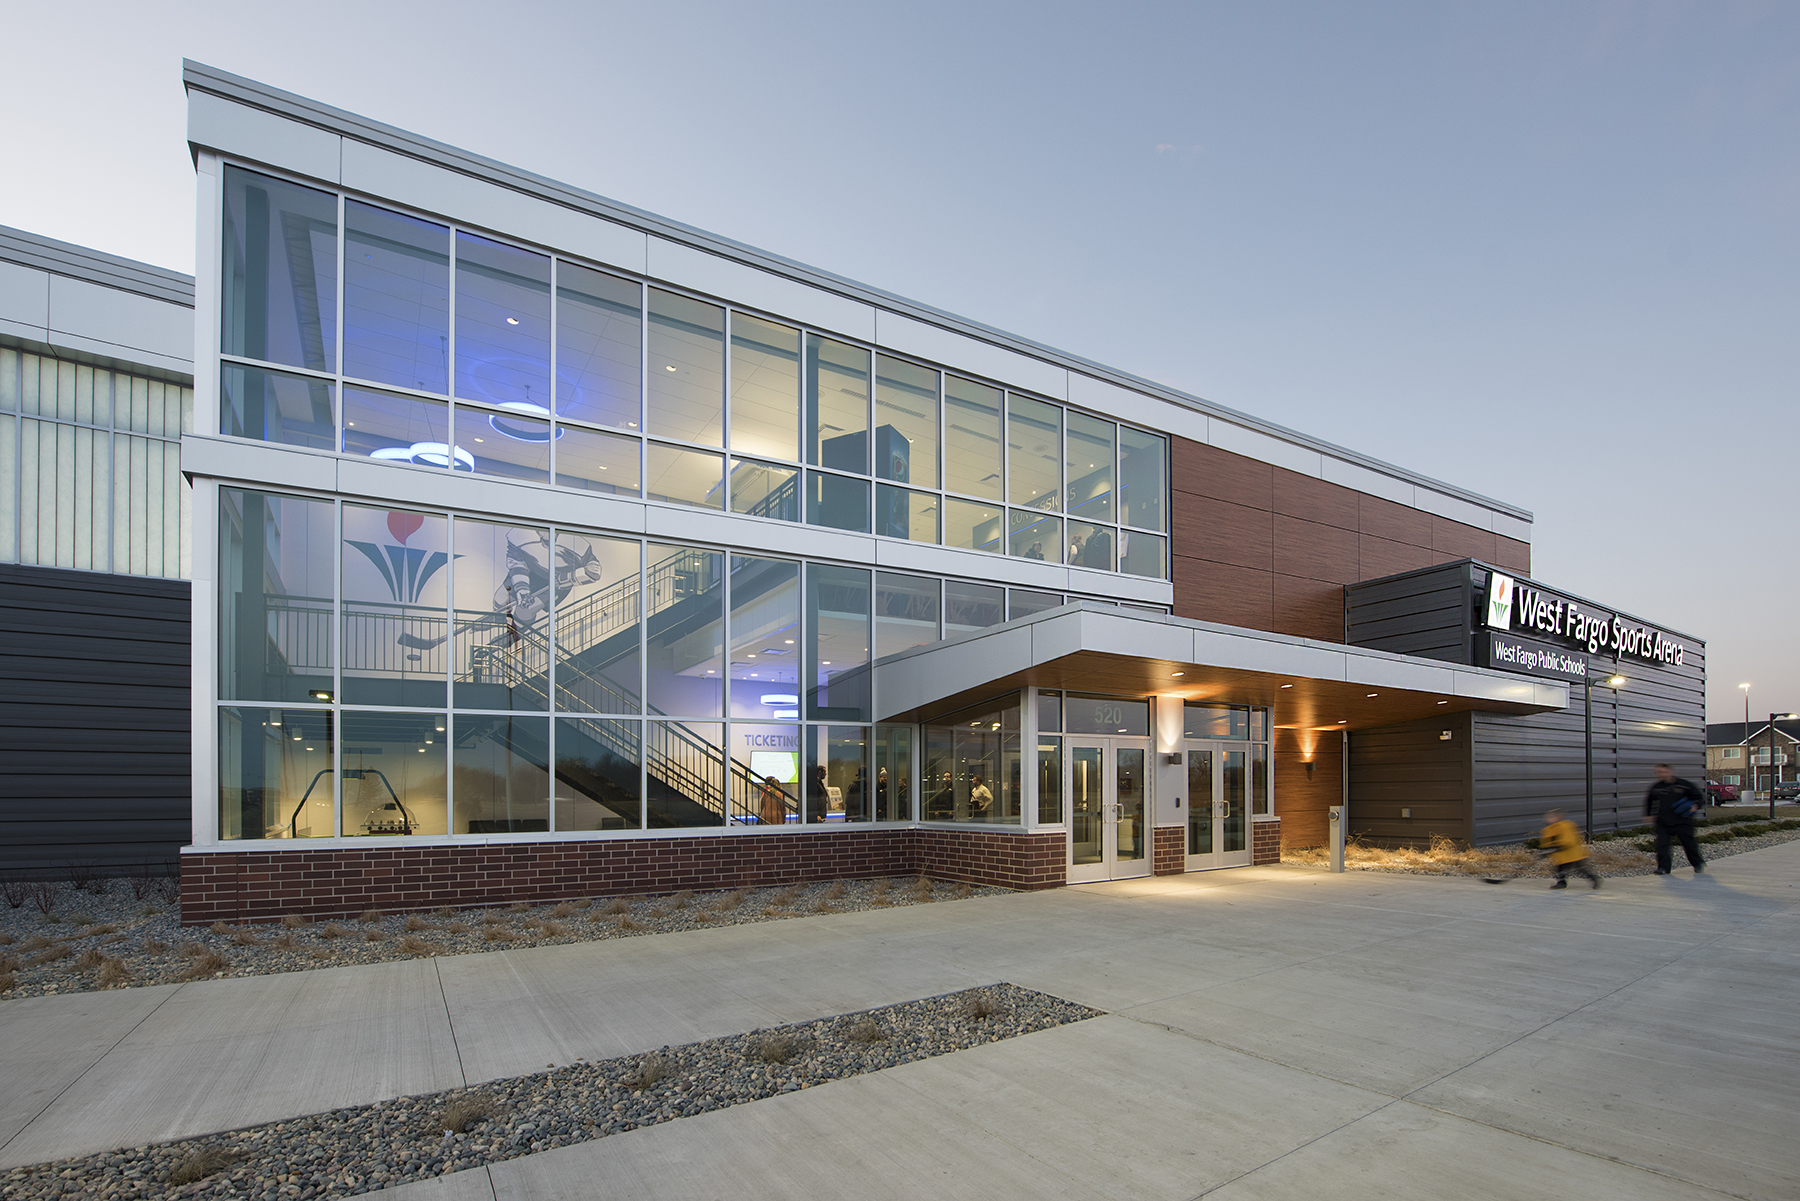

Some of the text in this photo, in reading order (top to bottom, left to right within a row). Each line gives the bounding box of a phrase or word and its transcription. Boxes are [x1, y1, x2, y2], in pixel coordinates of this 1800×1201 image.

[1519, 586, 1684, 666] West Fargo Sports Arena
[1495, 641, 1586, 676] West Fargo Public Schools
[1094, 706, 1122, 725] 520
